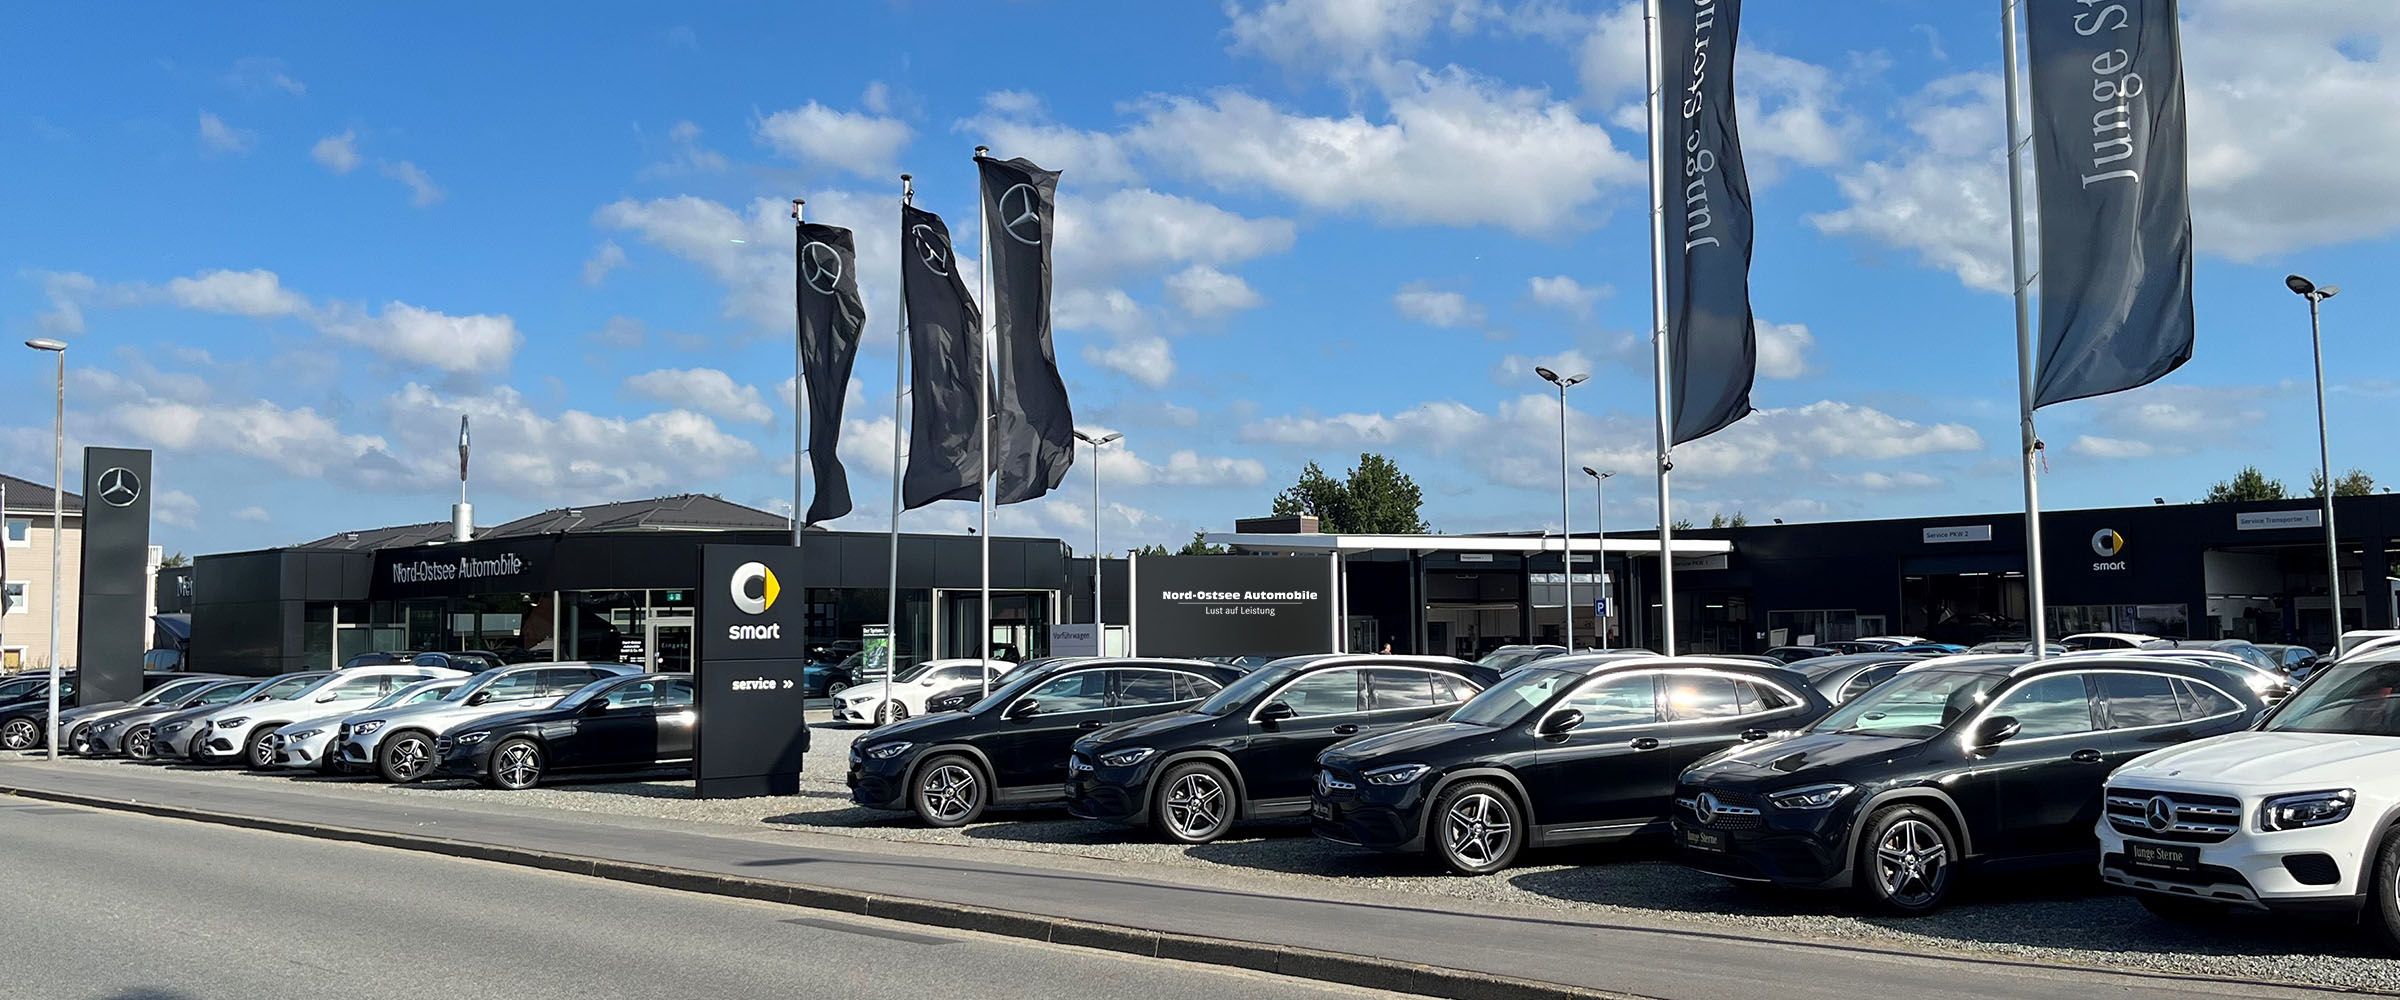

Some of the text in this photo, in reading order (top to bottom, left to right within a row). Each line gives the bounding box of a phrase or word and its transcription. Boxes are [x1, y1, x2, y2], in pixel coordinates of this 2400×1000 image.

[2081, 49, 2143, 190] Junge
[2265, 516, 2303, 524] Transporter
[393, 553, 522, 584] Nord-Ostsee Automobile
[2093, 560, 2126, 571] smart
[1162, 590, 1318, 600] Nord-Ostsee Automobile
[1205, 606, 1276, 617] Lust auf Leistung
[728, 622, 781, 640] smart
[1053, 631, 1091, 641] Vorführwagen
[731, 676, 777, 691] service
[2133, 844, 2184, 862] Junge Sterne
